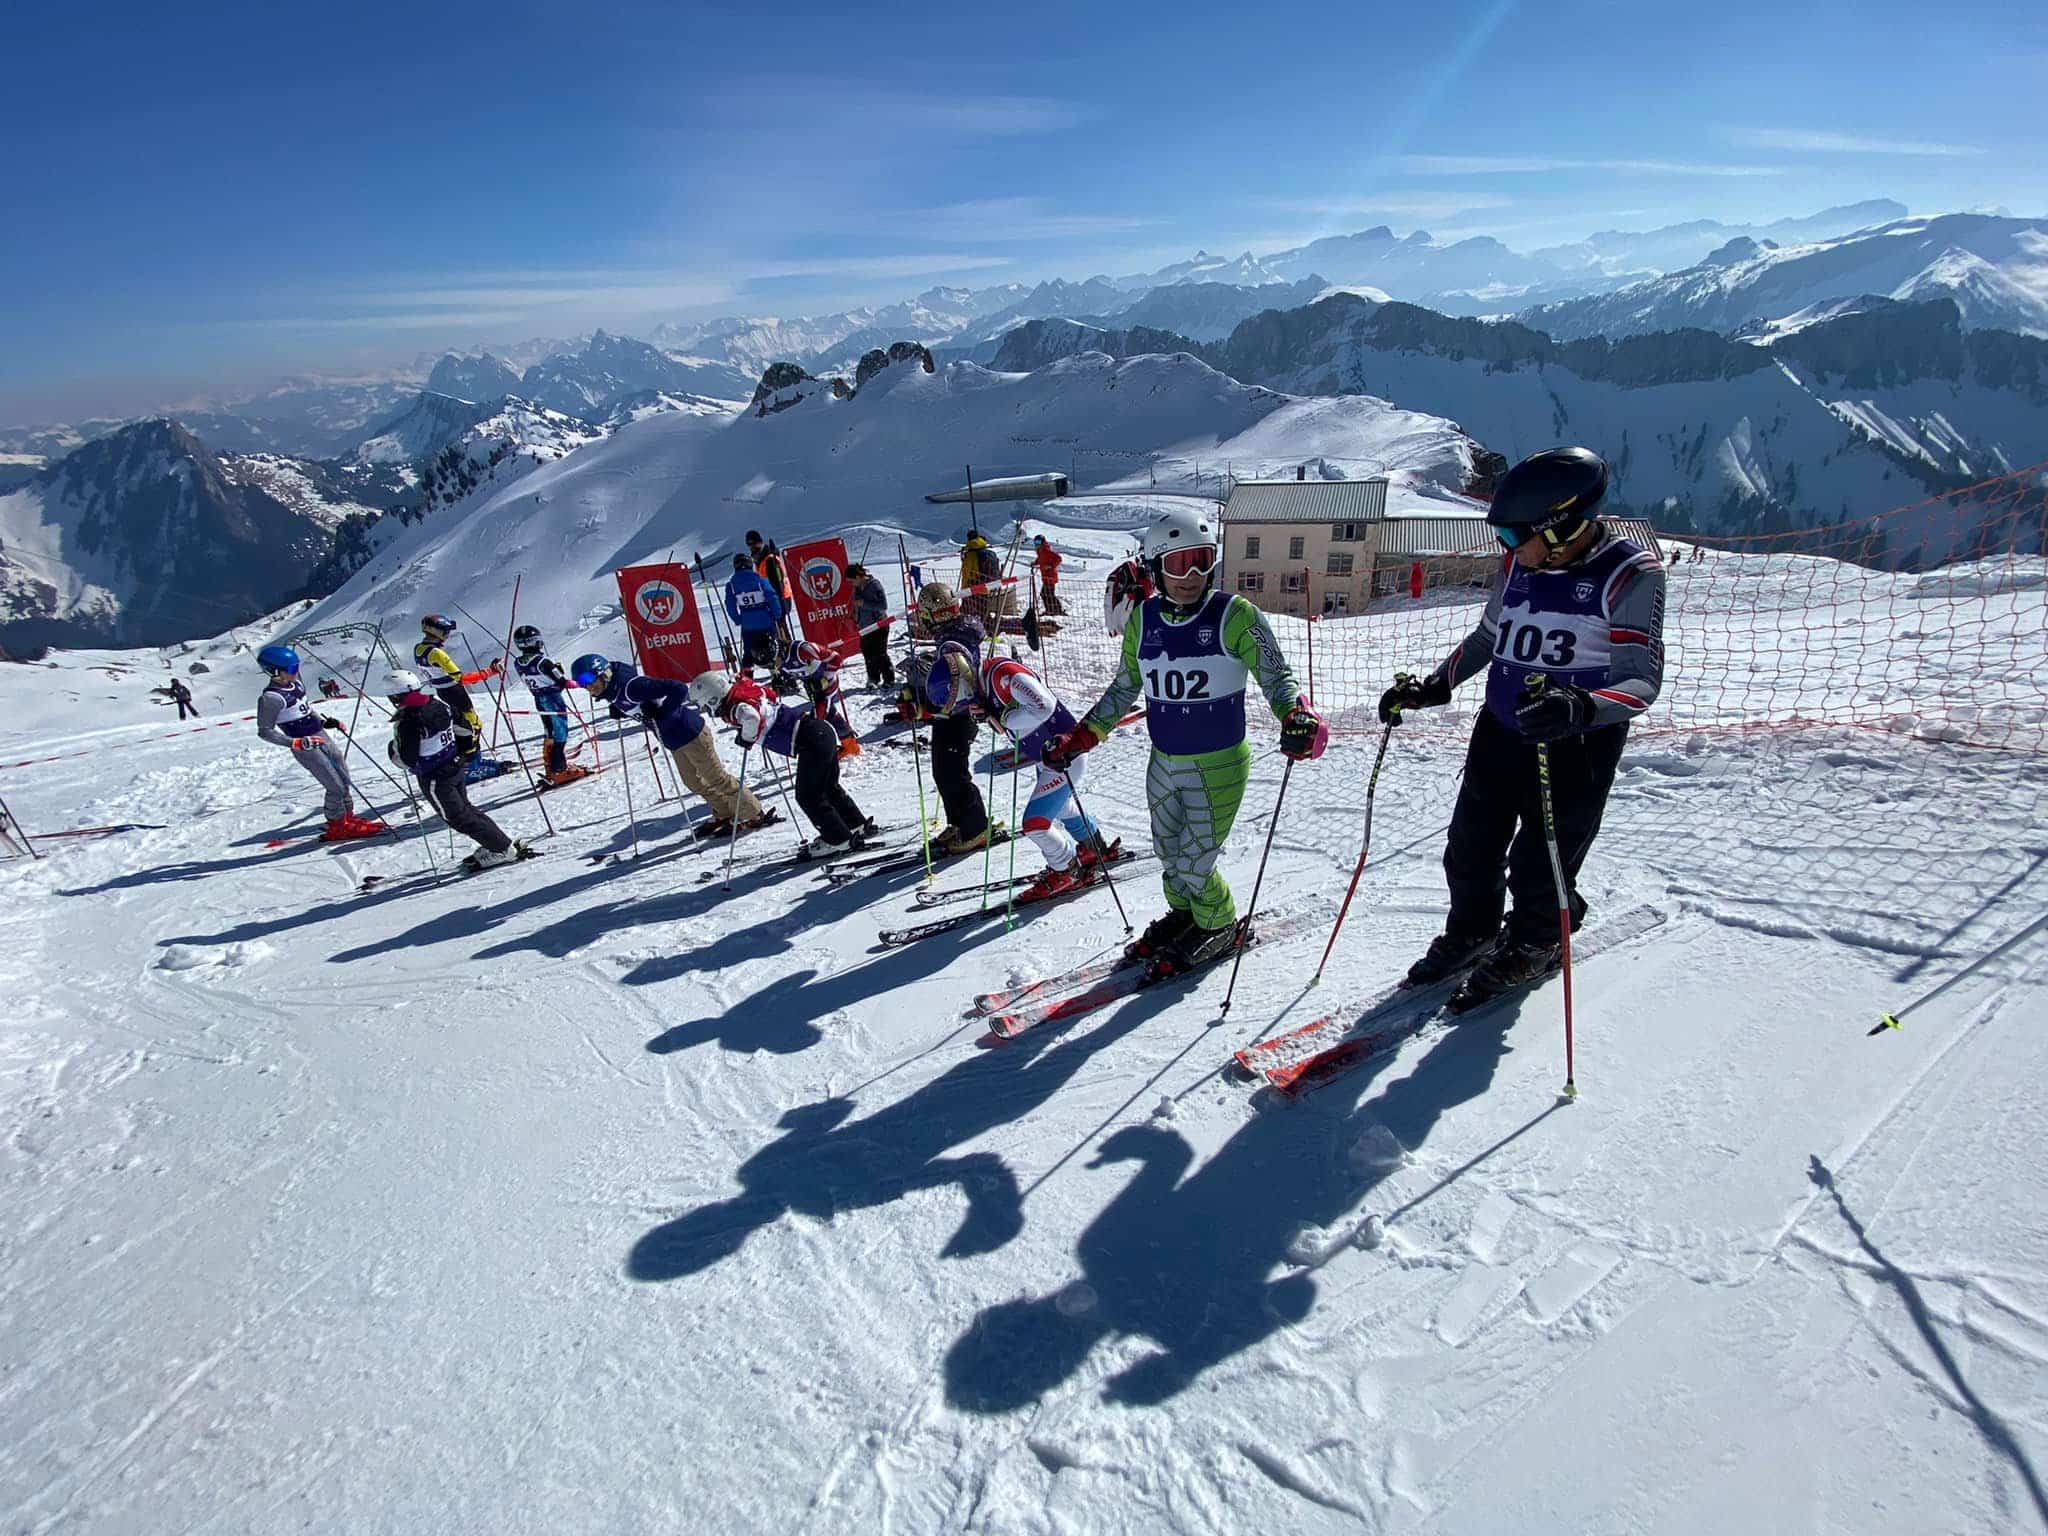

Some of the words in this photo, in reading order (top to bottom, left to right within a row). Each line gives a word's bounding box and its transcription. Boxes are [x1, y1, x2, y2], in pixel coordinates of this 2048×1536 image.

[742, 595, 756, 605] 91
[807, 603, 849, 622] DÉPART
[645, 632, 692, 649] DÉPART
[1496, 618, 1577, 667] 103
[1146, 669, 1210, 700] 102
